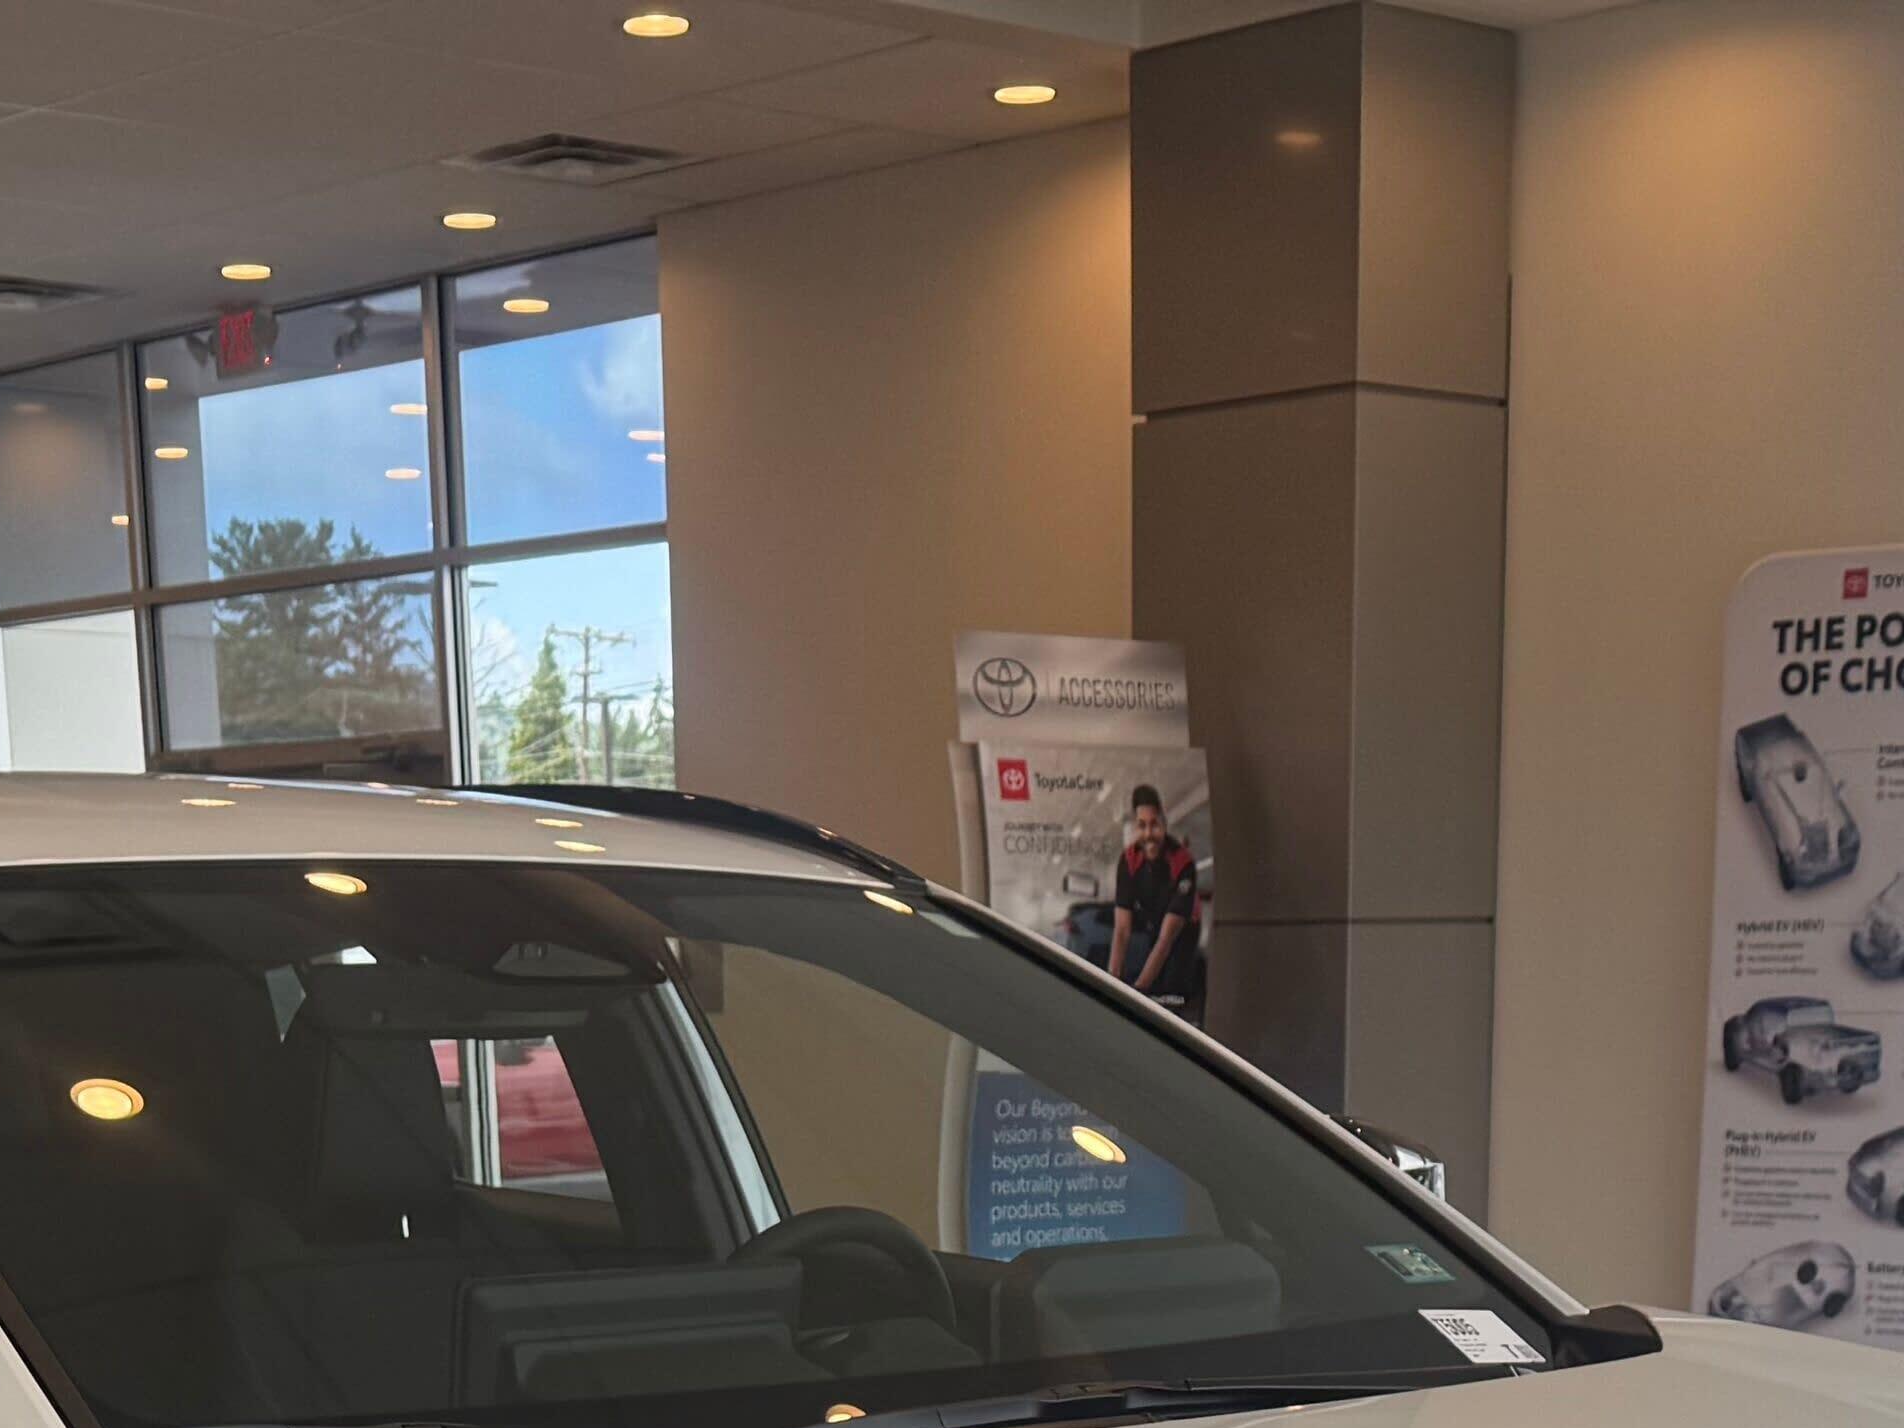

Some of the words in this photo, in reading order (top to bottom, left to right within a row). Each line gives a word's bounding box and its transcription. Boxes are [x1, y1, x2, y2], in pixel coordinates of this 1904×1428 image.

[1773, 616, 1845, 655] THE
[1780, 660, 1832, 696] OF
[1058, 676, 1175, 711] ACCESSORIES
[1034, 772, 1104, 792] ToyotaCare
[996, 1099, 1027, 1118] Our
[993, 1124, 1037, 1143] vision
[992, 1149, 1050, 1173] beyond
[992, 1175, 1063, 1197] neutrality
[1066, 1173, 1098, 1191] with
[1102, 1174, 1128, 1190] our
[992, 1199, 1062, 1223] products,
[1067, 1196, 1126, 1216] services
[992, 1226, 1021, 1247] and
